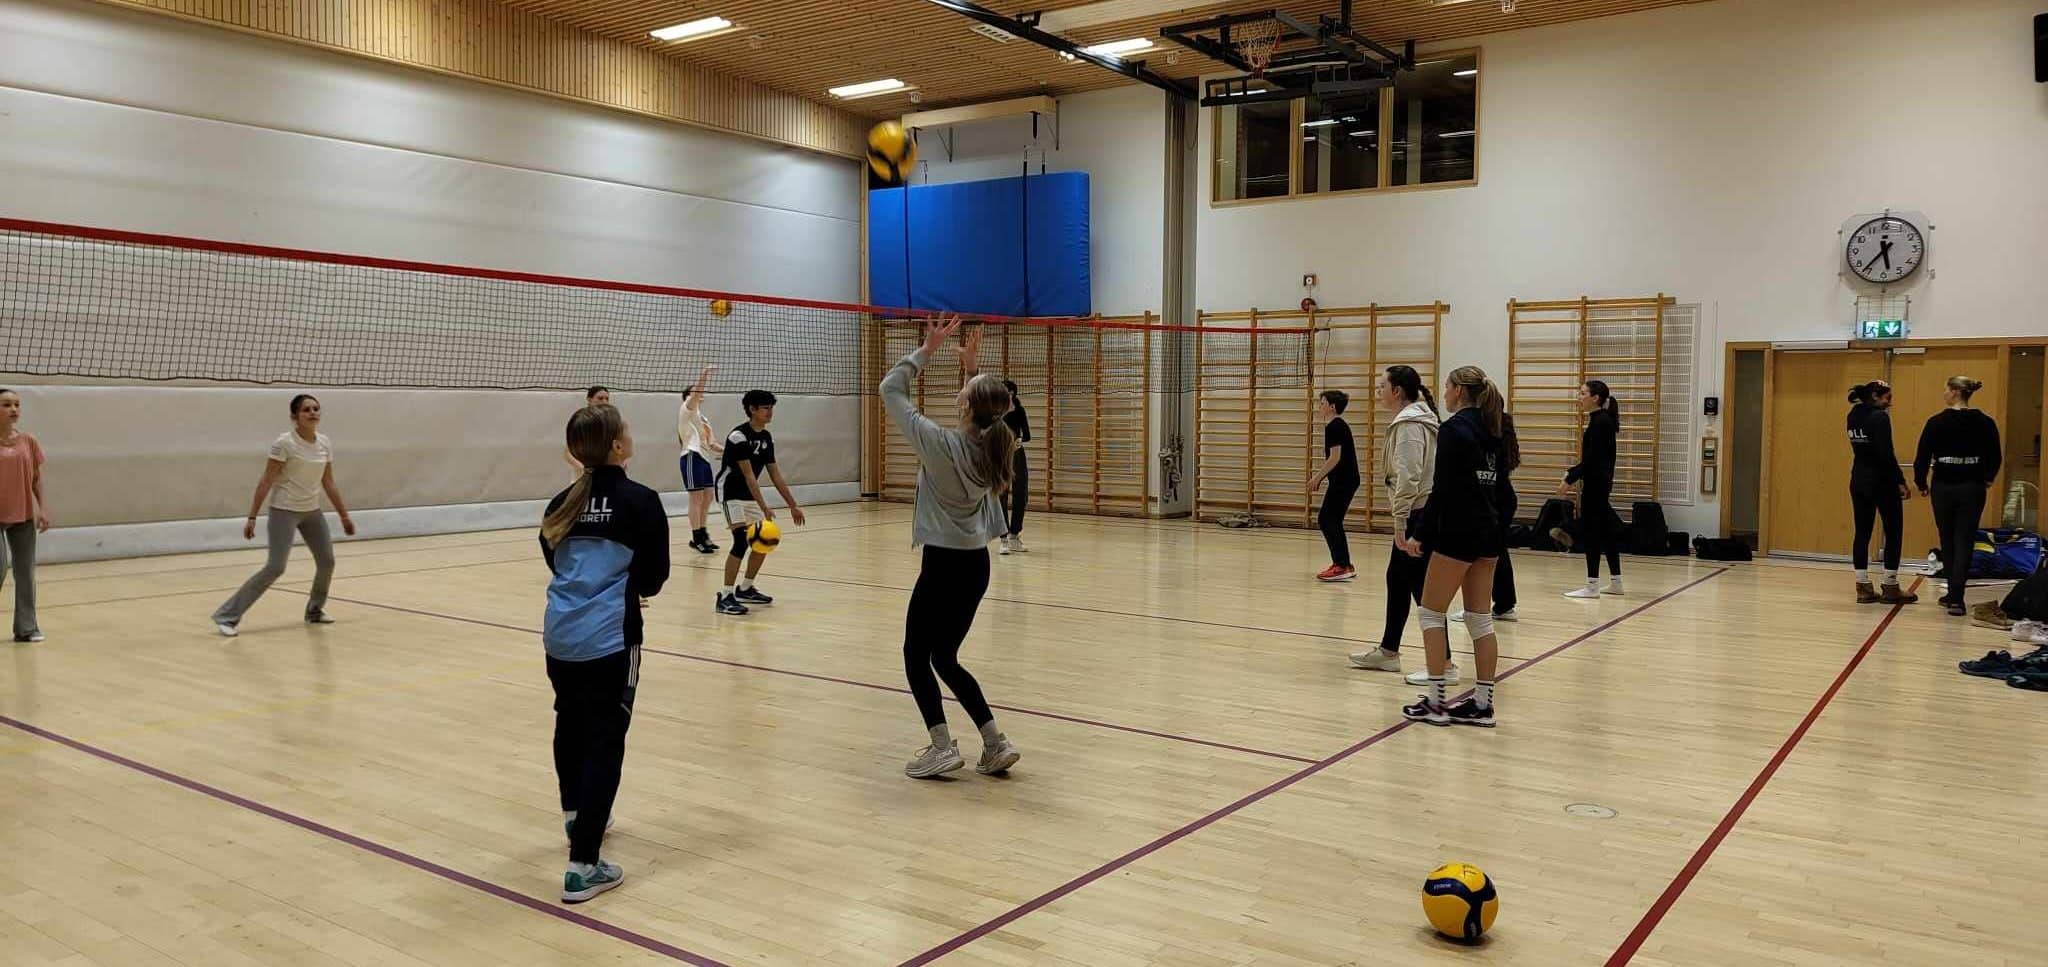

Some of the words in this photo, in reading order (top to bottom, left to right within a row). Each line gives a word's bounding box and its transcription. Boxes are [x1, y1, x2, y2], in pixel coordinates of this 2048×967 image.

[1907, 233, 1914, 241] 2
[1911, 245, 1917, 253] 3
[1856, 260, 1862, 268] 8
[1880, 271, 1887, 279] 6
[1896, 267, 1902, 275] 5
